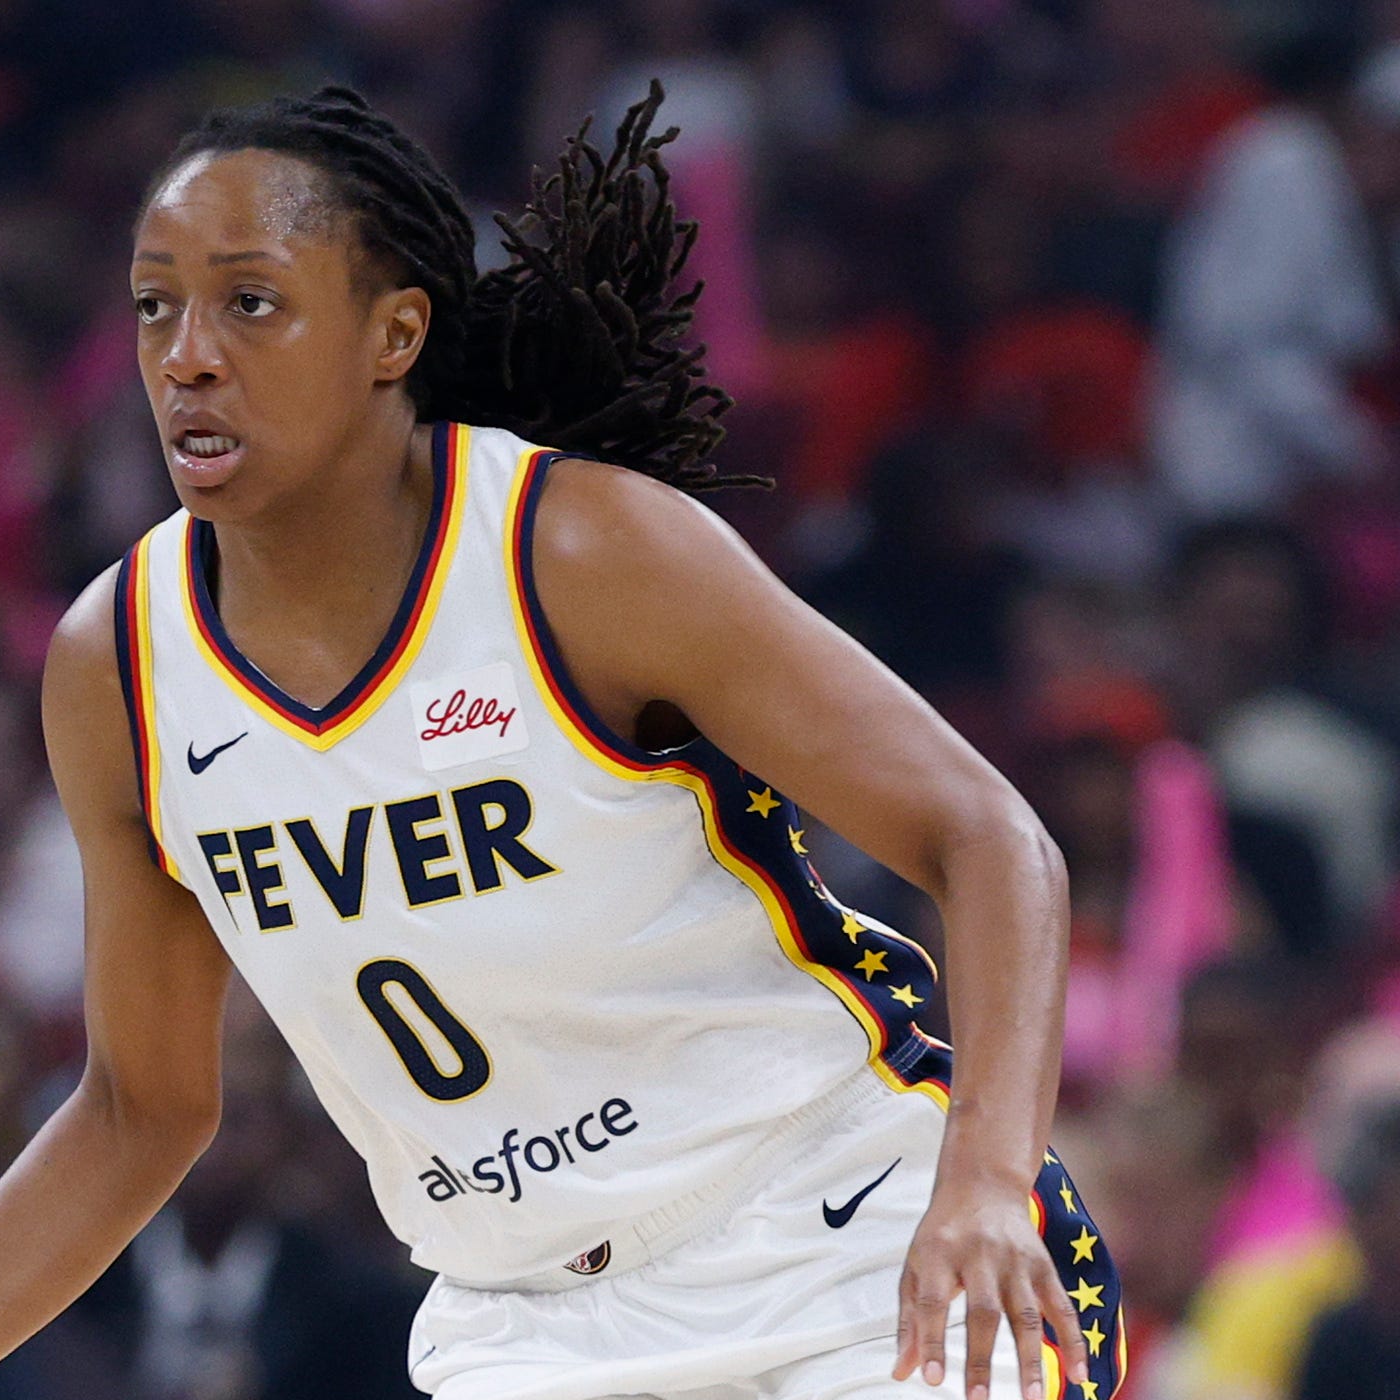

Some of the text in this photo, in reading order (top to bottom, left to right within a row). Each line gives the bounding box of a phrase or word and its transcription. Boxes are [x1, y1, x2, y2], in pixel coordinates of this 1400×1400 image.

[421, 689, 517, 741] Lilly
[196, 775, 565, 935] FEVER
[355, 955, 494, 1104] 0
